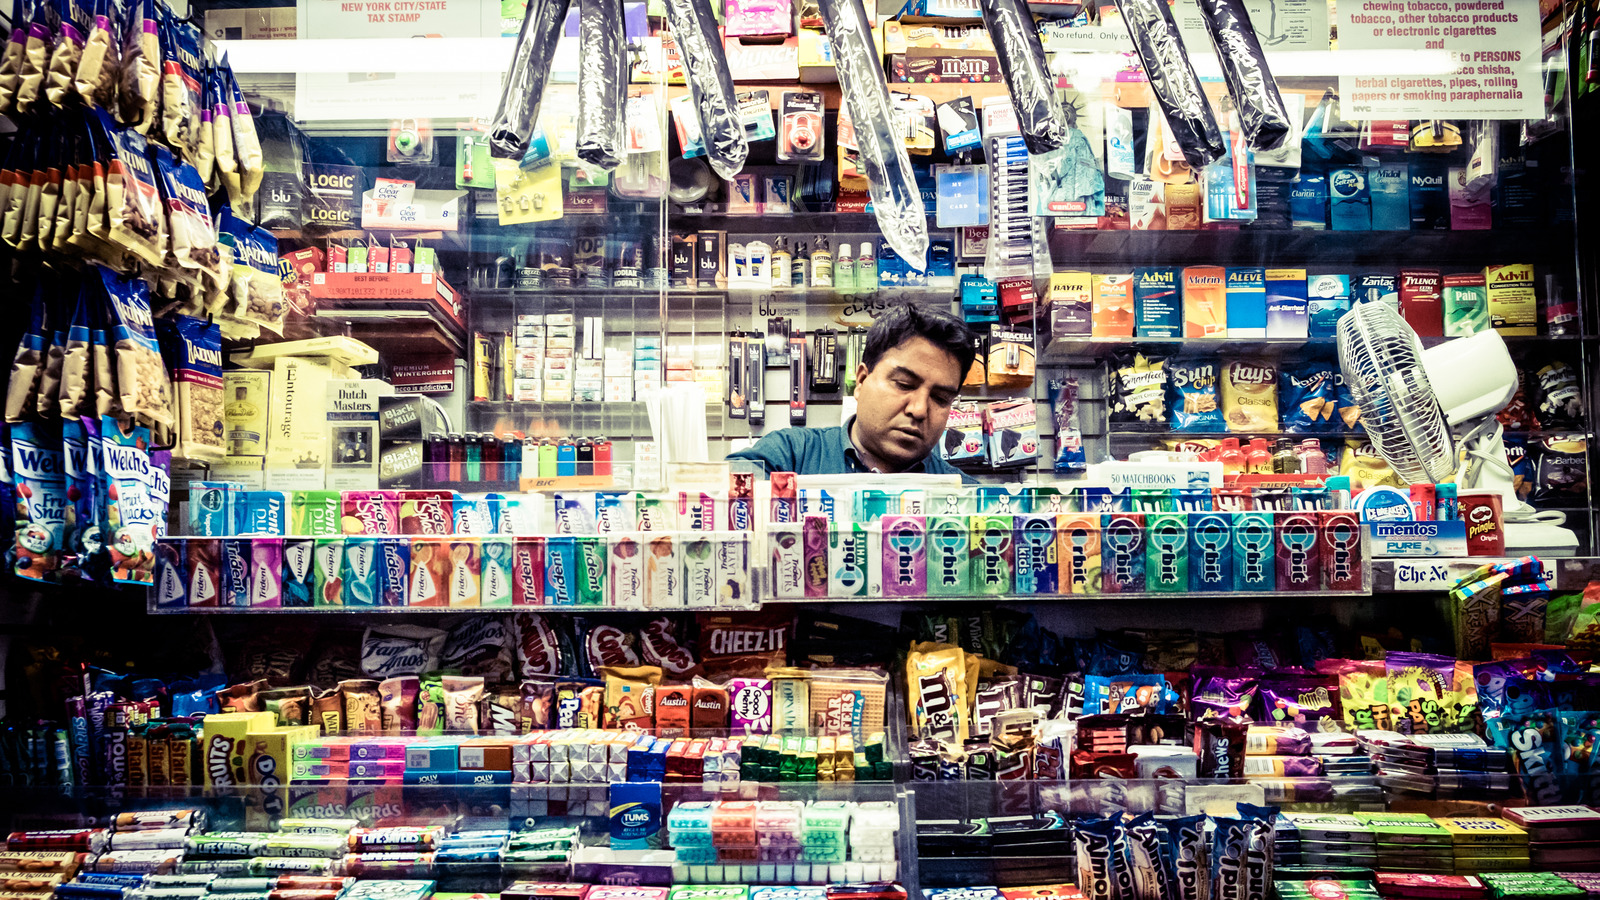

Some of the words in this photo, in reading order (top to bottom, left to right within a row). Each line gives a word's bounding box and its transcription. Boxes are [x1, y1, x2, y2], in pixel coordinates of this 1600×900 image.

[341, 2, 362, 12] NEW
[366, 2, 391, 12] YORK
[394, 2, 447, 12] CITY/STATE
[1363, 1, 1404, 12] chewing
[1407, 1, 1451, 11] tobacco,
[1455, 0, 1504, 12] powdered
[368, 13, 385, 23] TAX
[389, 13, 420, 23] STAMP
[1351, 14, 1395, 24] tobacco,
[1399, 13, 1425, 23] other
[1428, 13, 1469, 23] tobacco
[1472, 13, 1518, 24] products
[1066, 31, 1095, 39] refund.
[1100, 32, 1118, 40] Only
[1373, 28, 1383, 36] or
[1387, 26, 1439, 36] electronic
[1443, 25, 1497, 37] cigarettes
[1425, 39, 1444, 49] and
[1460, 52, 1470, 62] to
[1474, 51, 1521, 62] PERSONS
[1478, 65, 1514, 76] shisha,
[1355, 78, 1387, 88] herbal
[1391, 77, 1446, 89] cigarettes,
[1450, 77, 1481, 89] pipes,
[1484, 77, 1517, 88] rolling
[1352, 92, 1386, 102] papers
[1390, 92, 1400, 100] or
[1403, 90, 1447, 101] smoking
[1450, 89, 1523, 102] paraphernalia
[310, 174, 355, 188] LOGIC
[1412, 176, 1442, 187] NyQuil
[271, 190, 291, 203] blu
[378, 187, 399, 195] Clear
[311, 209, 351, 222] LOGIC
[442, 210, 448, 218] 8
[674, 252, 688, 264] blu
[701, 255, 716, 269] blu
[1141, 272, 1174, 283] Advil
[1188, 275, 1221, 285] Motrin
[1228, 272, 1263, 282] ALEVE
[1362, 277, 1395, 286] Zantac
[1405, 276, 1438, 286] TYLENOL
[1494, 271, 1530, 282] Advil
[1001, 281, 1032, 289] TROJAN
[1455, 290, 1477, 301] Pain
[759, 300, 776, 317] blu
[992, 331, 1034, 340] DURACELL
[395, 369, 453, 377] WINTERGREEN
[1174, 365, 1213, 387] Sun
[338, 389, 367, 400] Dutch
[281, 369, 297, 438] Entourage
[334, 401, 372, 411] Masters
[1237, 396, 1271, 407] Classic
[384, 404, 414, 419] Black
[393, 412, 417, 427] Mild
[383, 447, 418, 464] Black
[109, 450, 150, 475] Welch's
[393, 457, 419, 473] Mild
[1111, 474, 1120, 483] 50
[1122, 473, 1176, 484] MATCHBOOKS
[1377, 523, 1438, 536] mentos
[1469, 521, 1497, 539] Pringles
[855, 533, 865, 566] WHITE
[226, 541, 244, 593] Trident
[385, 539, 402, 593] Trident
[583, 540, 602, 593] Trident
[1016, 547, 1028, 575] kids
[523, 551, 538, 604] Trident
[555, 551, 570, 604] Trident
[783, 553, 792, 593] LAYERS
[1399, 565, 1424, 583] The
[165, 567, 173, 599] Trident
[198, 567, 206, 599] Trident
[622, 562, 631, 601] LAYERS
[695, 562, 703, 601] LAYERS
[710, 628, 786, 654] CHEEZ-IT
[660, 695, 687, 707] Austin
[694, 700, 721, 710] Austin
[740, 688, 749, 717] Plenty
[752, 690, 761, 716] Good
[209, 737, 233, 796] FRUITS
[419, 774, 437, 784] JOLLY
[474, 774, 493, 784] JOLLY
[623, 813, 649, 822] TUMS
[361, 833, 382, 844] LIFE
[384, 833, 419, 844] SAVERS
[199, 842, 218, 855] LIFE
[603, 876, 640, 886] TUMS
[679, 888, 741, 899] Extra
